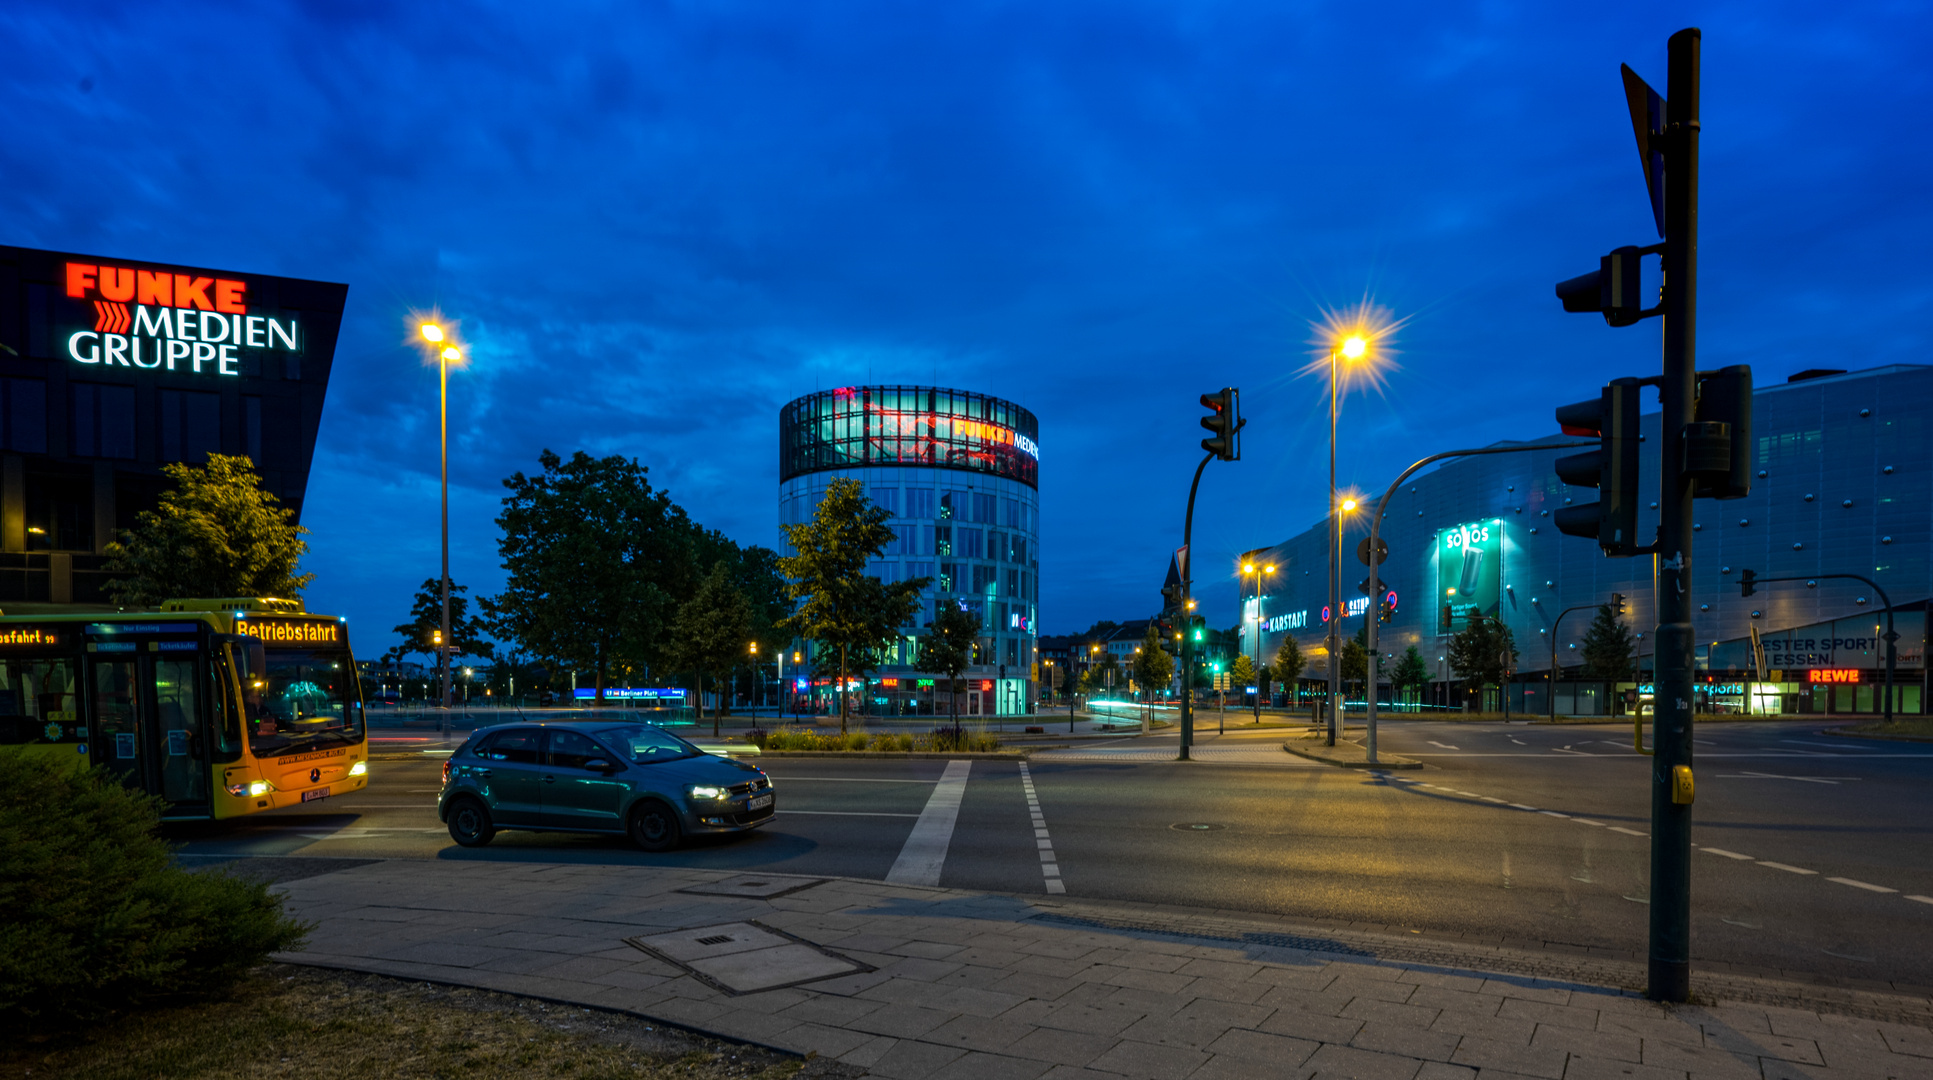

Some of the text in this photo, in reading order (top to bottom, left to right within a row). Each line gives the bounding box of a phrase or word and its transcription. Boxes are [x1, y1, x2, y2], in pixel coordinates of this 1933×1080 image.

[66, 262, 246, 314] FUNKE
[133, 304, 297, 350] MEDIEN
[68, 331, 239, 376] GRUPPE
[953, 419, 1005, 444] FUNKE
[237, 620, 337, 642] Betriebsfahrt
[1269, 610, 1308, 632] KARSTADT
[1751, 637, 1878, 651] ESTER SPORT
[1774, 653, 1836, 666] ESSEN.
[882, 678, 898, 686] WAZ
[1809, 669, 1860, 682] REWE
[620, 690, 643, 698] Berliner
[644, 690, 658, 698] Platz
